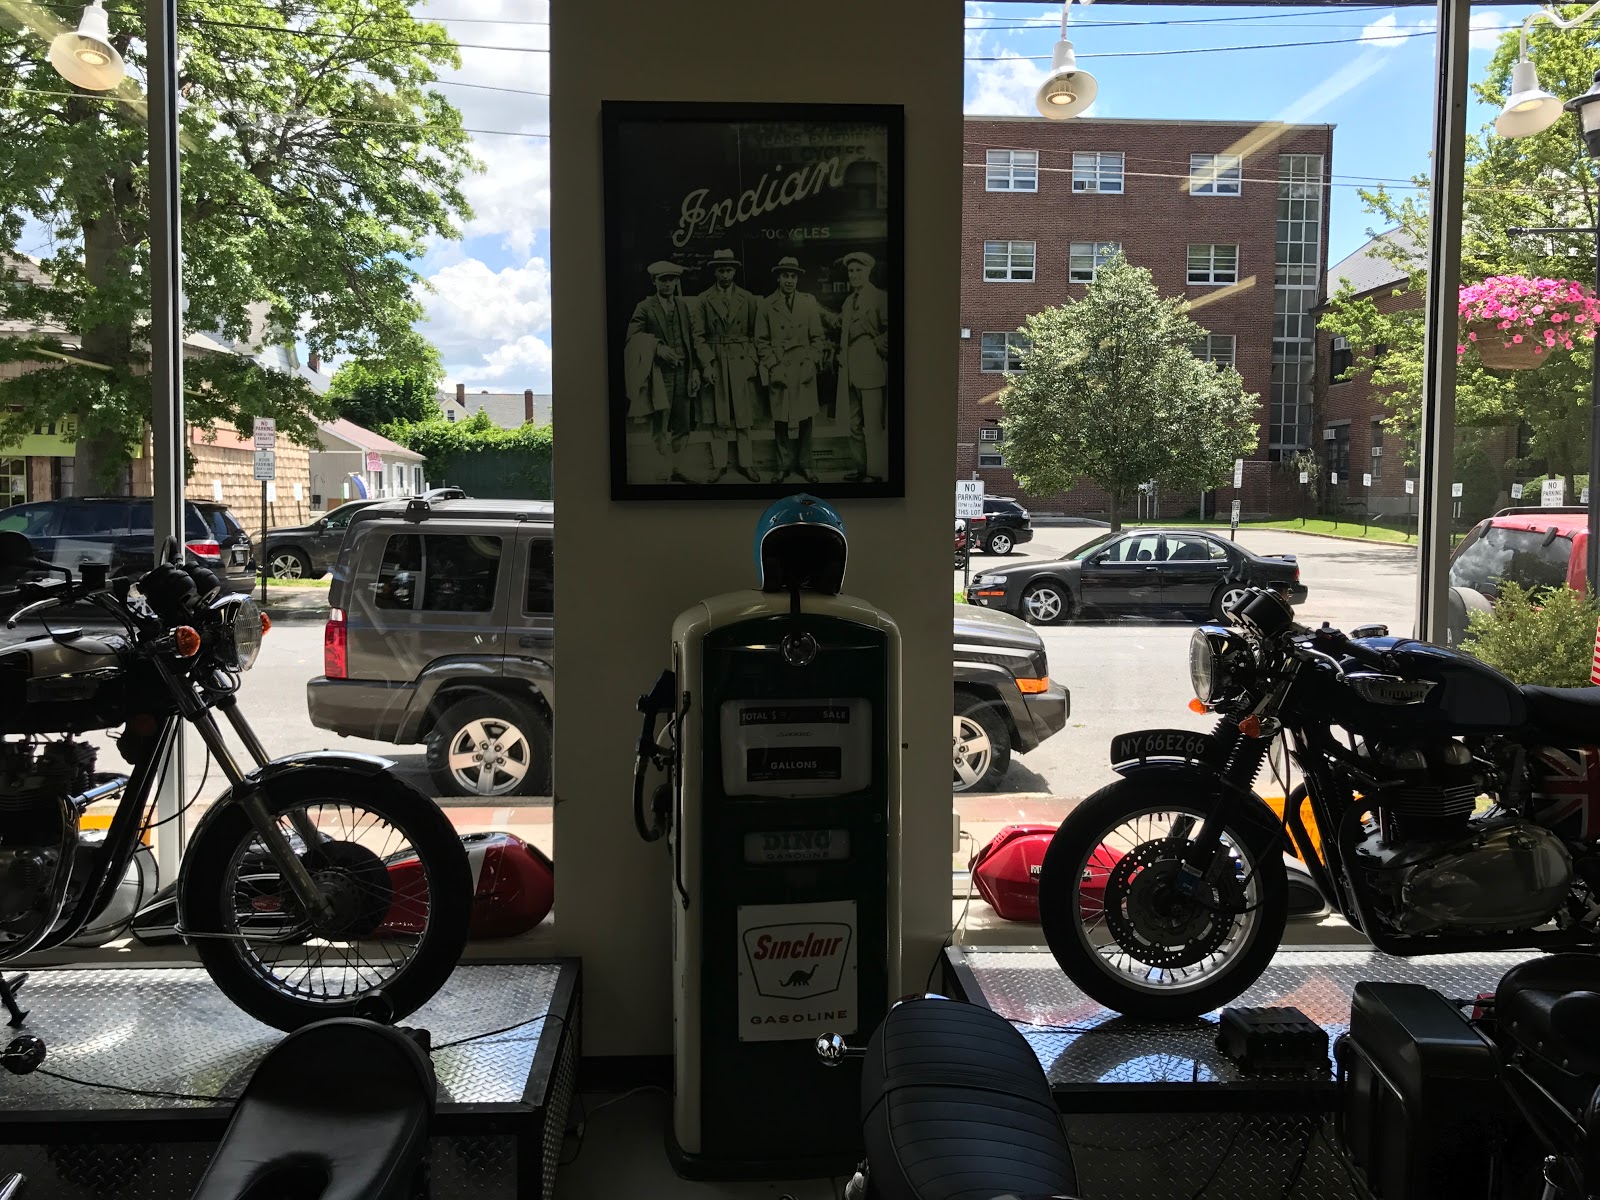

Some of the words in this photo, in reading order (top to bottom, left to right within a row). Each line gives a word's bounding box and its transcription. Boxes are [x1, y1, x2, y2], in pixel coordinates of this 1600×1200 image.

[672, 157, 844, 248] Indian
[964, 484, 976, 492] NO
[741, 711, 768, 721] TOTAL
[771, 710, 777, 720] $
[822, 710, 846, 720] SALE
[1120, 736, 1143, 757] NY
[770, 760, 818, 770] GALLONS
[760, 831, 830, 850] DINO
[767, 851, 830, 860] GASOLINE
[753, 931, 844, 961] Sinclair
[750, 1009, 848, 1025] GASOLINE
